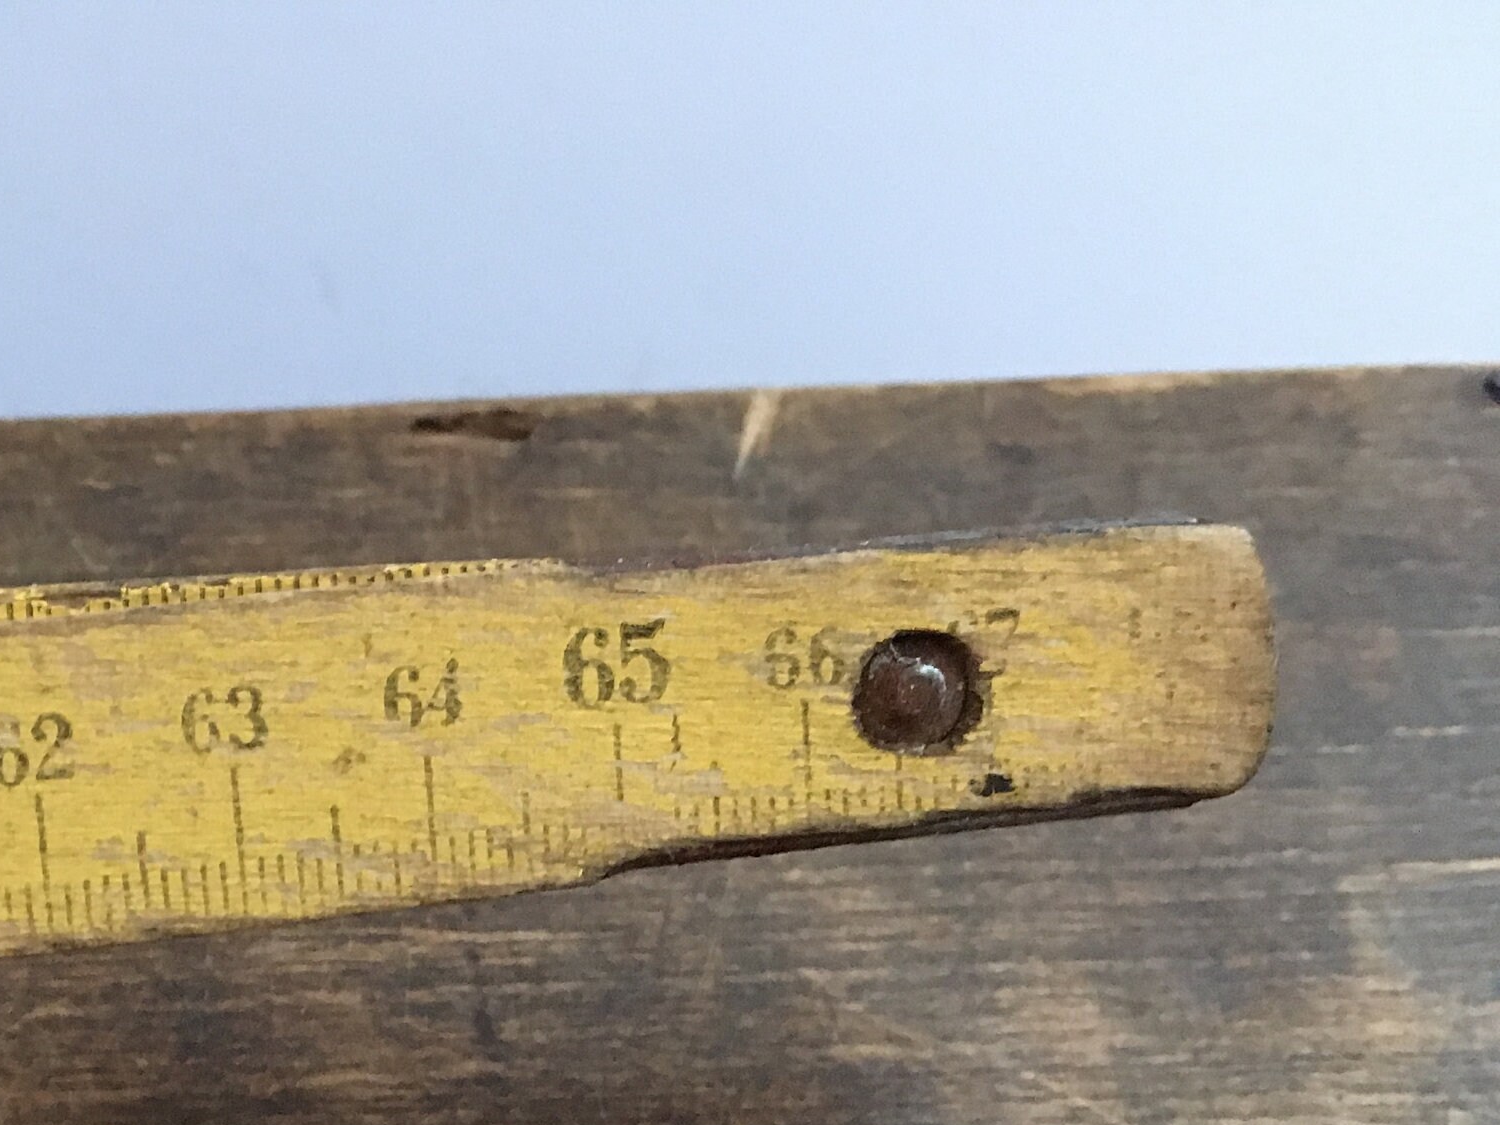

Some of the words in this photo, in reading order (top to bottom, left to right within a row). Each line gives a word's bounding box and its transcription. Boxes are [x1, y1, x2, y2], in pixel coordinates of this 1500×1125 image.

[181, 685, 269, 755] 63
[383, 658, 463, 727] 64
[563, 617, 672, 709] 65
[764, 626, 845, 690] 66
[947, 607, 1021, 682] 7
